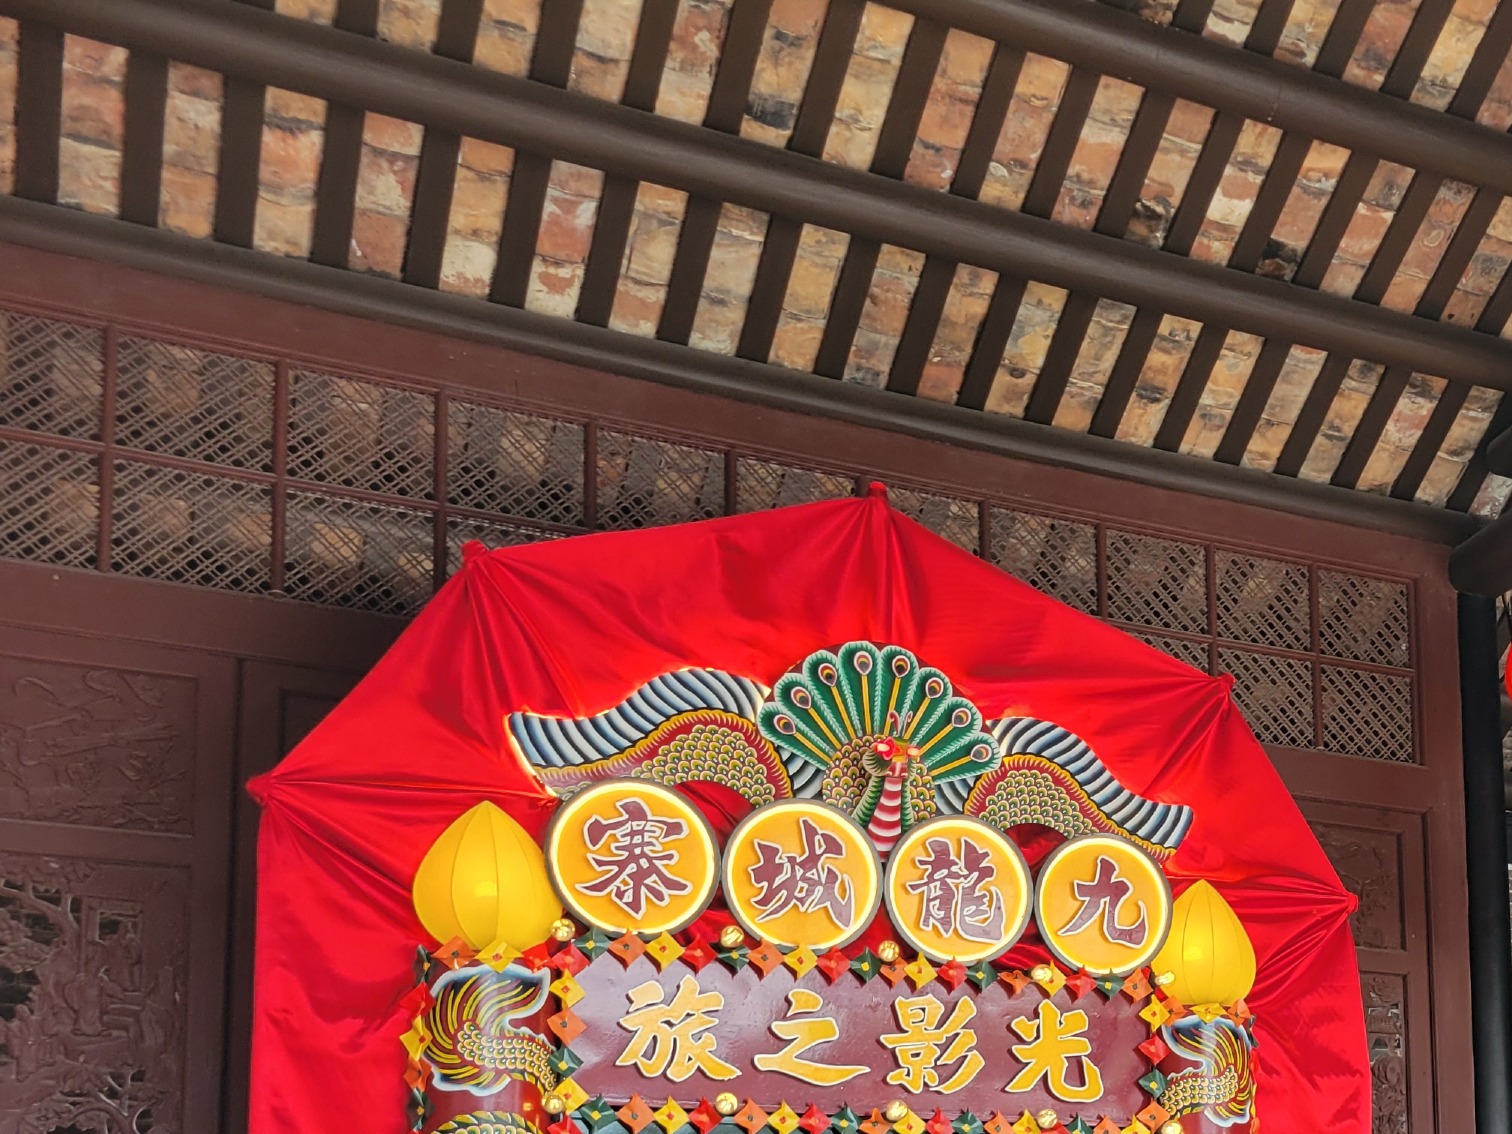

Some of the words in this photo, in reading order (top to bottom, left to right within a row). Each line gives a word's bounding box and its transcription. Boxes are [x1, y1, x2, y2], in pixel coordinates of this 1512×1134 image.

[574, 797, 1150, 949] 九龍城寨
[615, 974, 1104, 1103] 光影之旅
